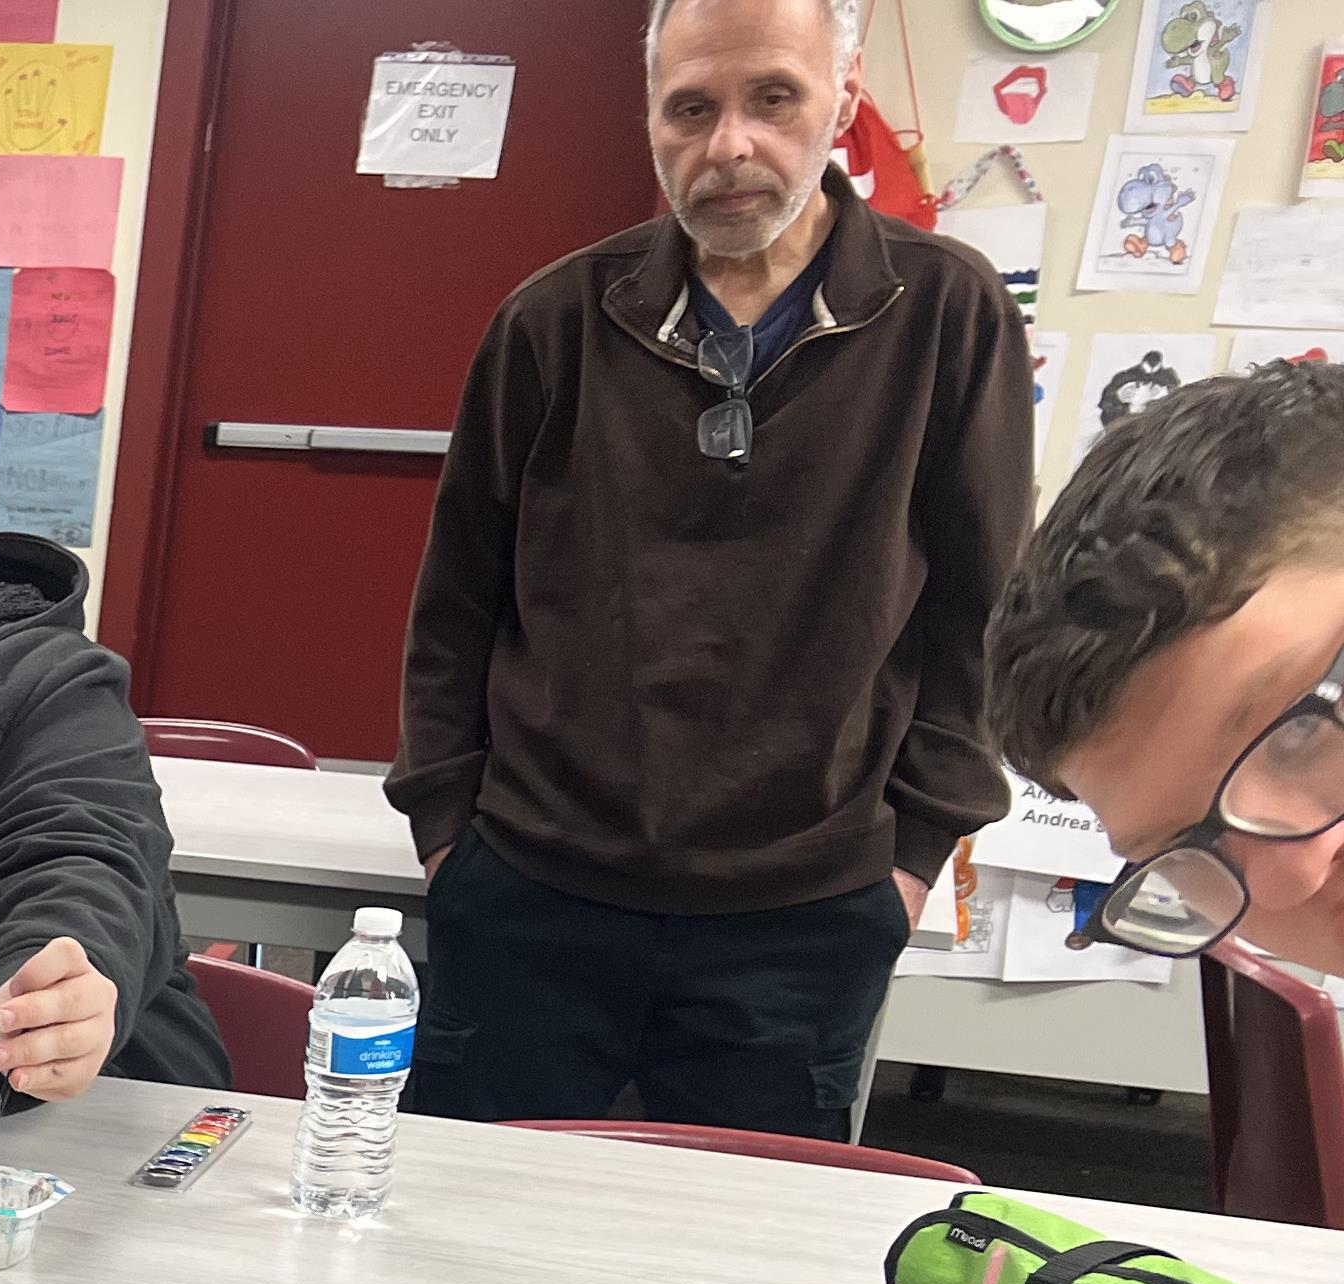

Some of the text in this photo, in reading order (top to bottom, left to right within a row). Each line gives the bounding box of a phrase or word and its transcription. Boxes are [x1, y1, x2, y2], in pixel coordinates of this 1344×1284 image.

[385, 80, 500, 99] EMERGENCY
[417, 103, 458, 120] EXIT
[410, 127, 459, 143] ONLY
[359, 1049, 402, 1062] drinking
[366, 1059, 395, 1070] water
